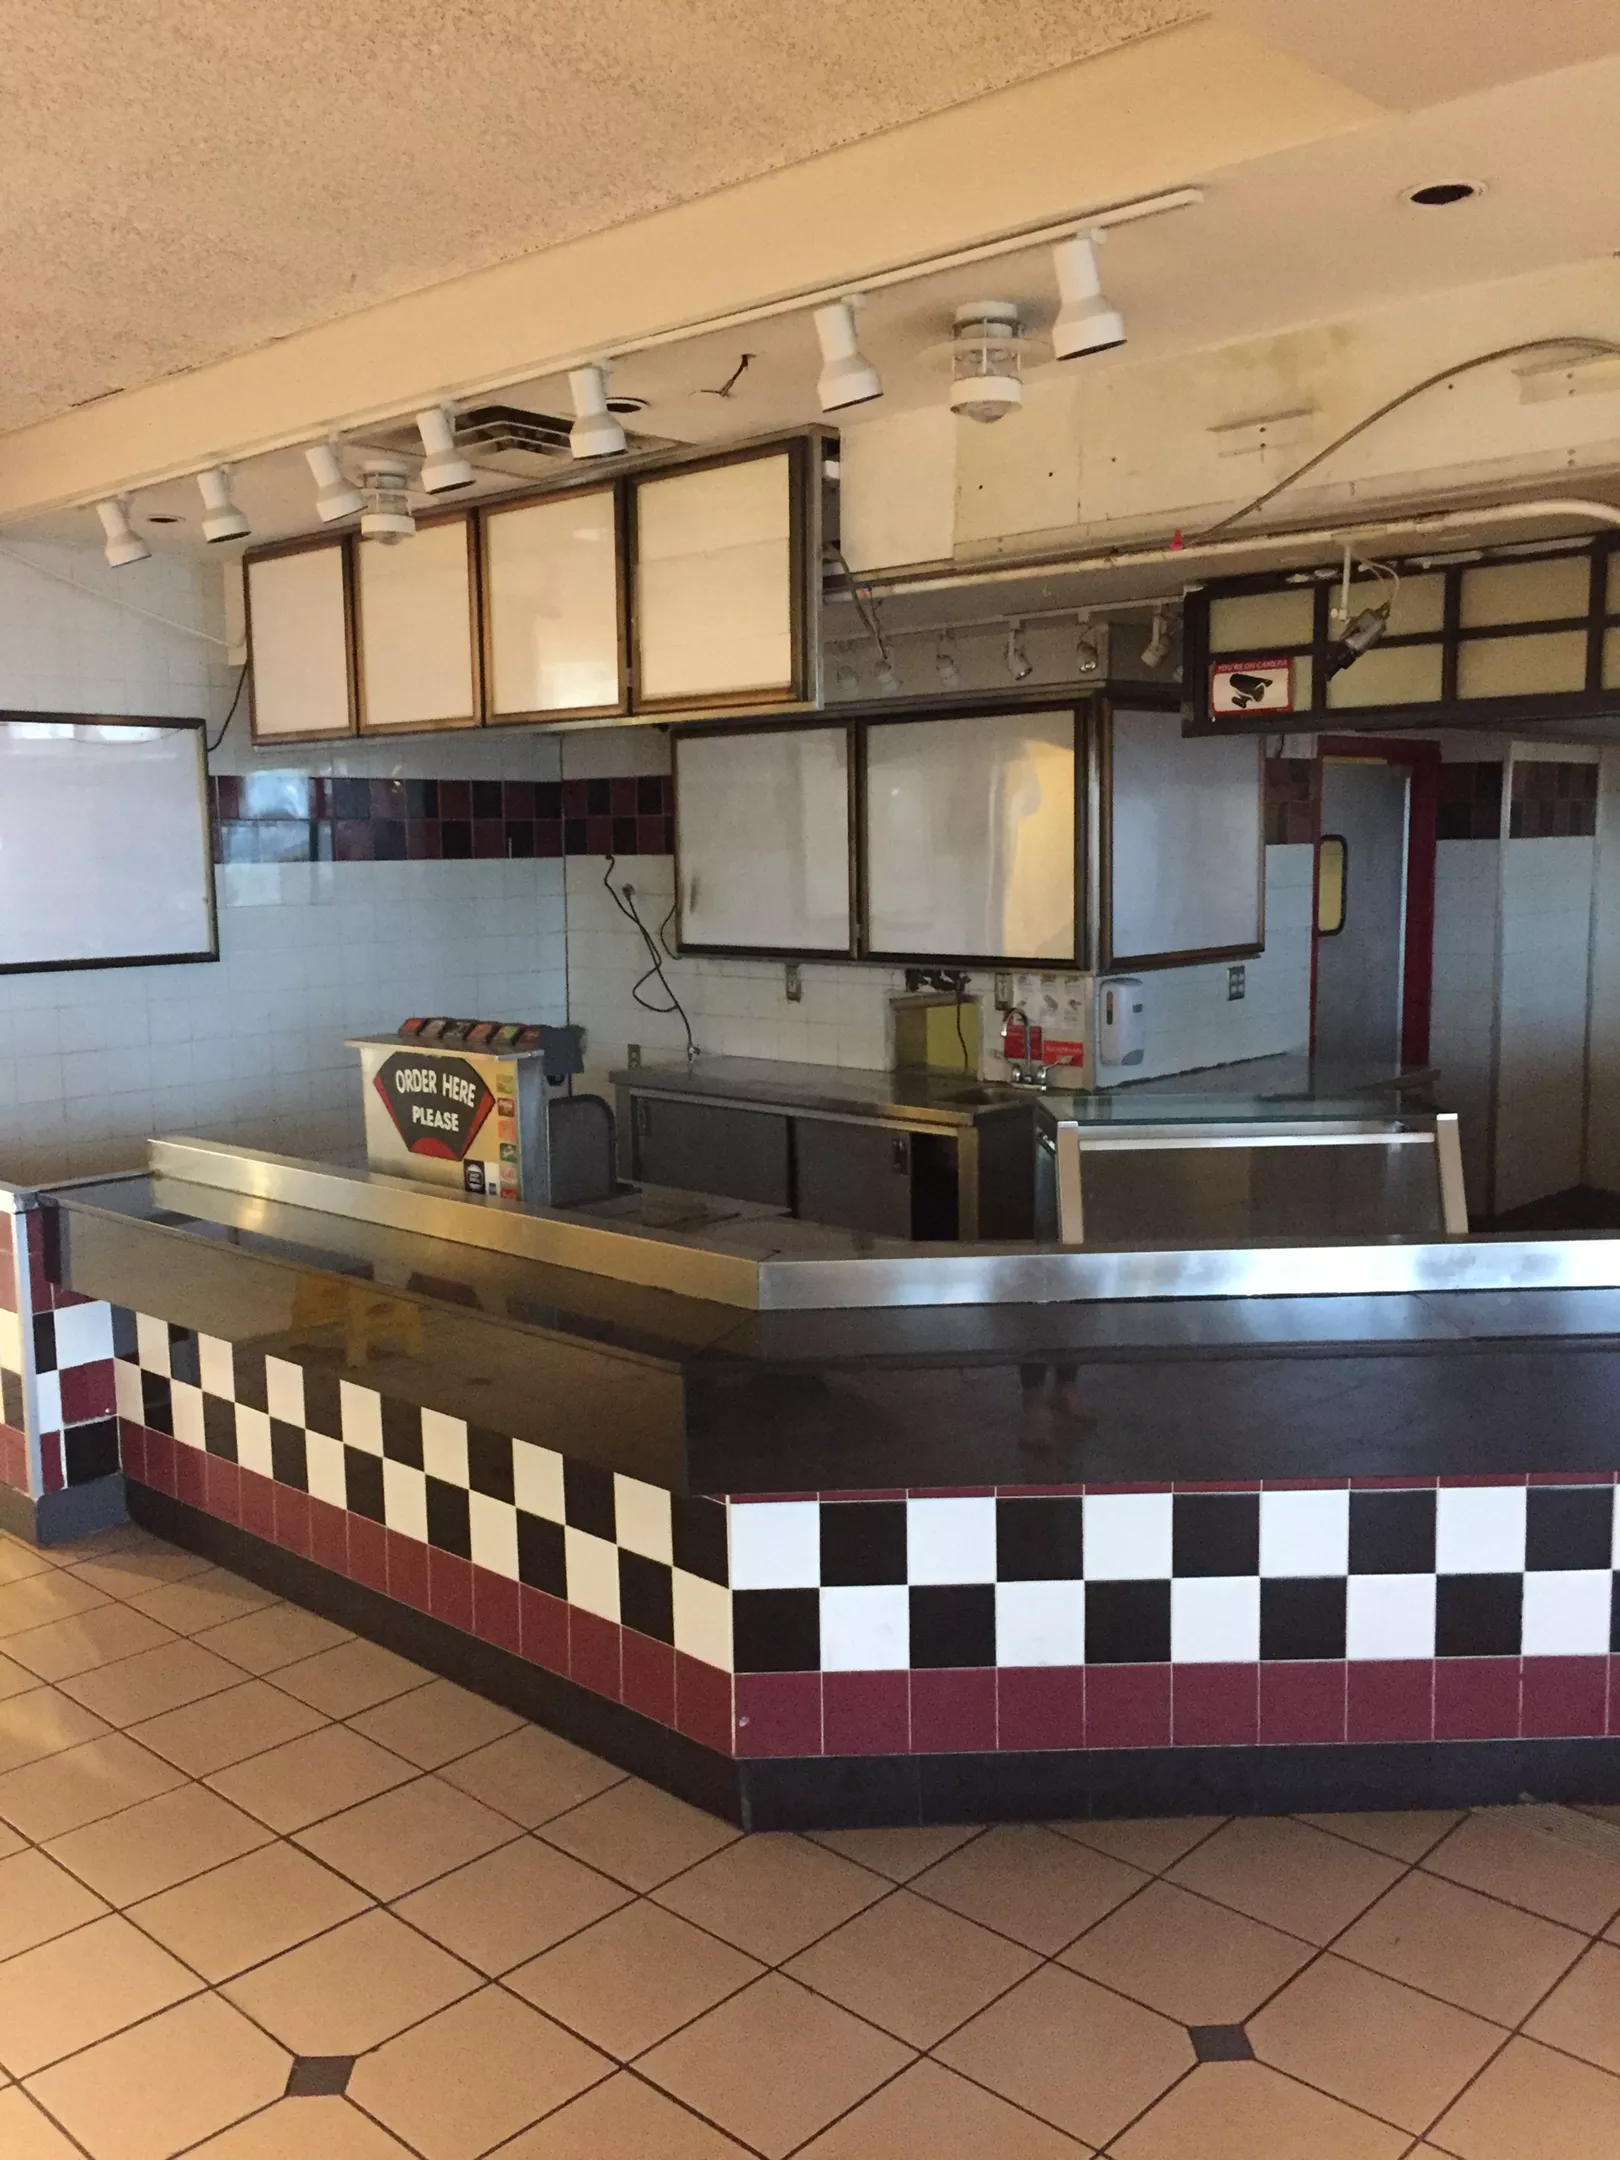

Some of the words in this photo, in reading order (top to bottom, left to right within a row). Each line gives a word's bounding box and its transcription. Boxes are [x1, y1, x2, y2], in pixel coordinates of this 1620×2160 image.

[1218, 663, 1243, 672] YOU'RE
[1244, 662, 1255, 670] ON
[1256, 659, 1288, 668] CAMERA
[395, 1068, 437, 1094] ORDER
[442, 1073, 475, 1108] HERE
[412, 1105, 459, 1131] PLEASE
